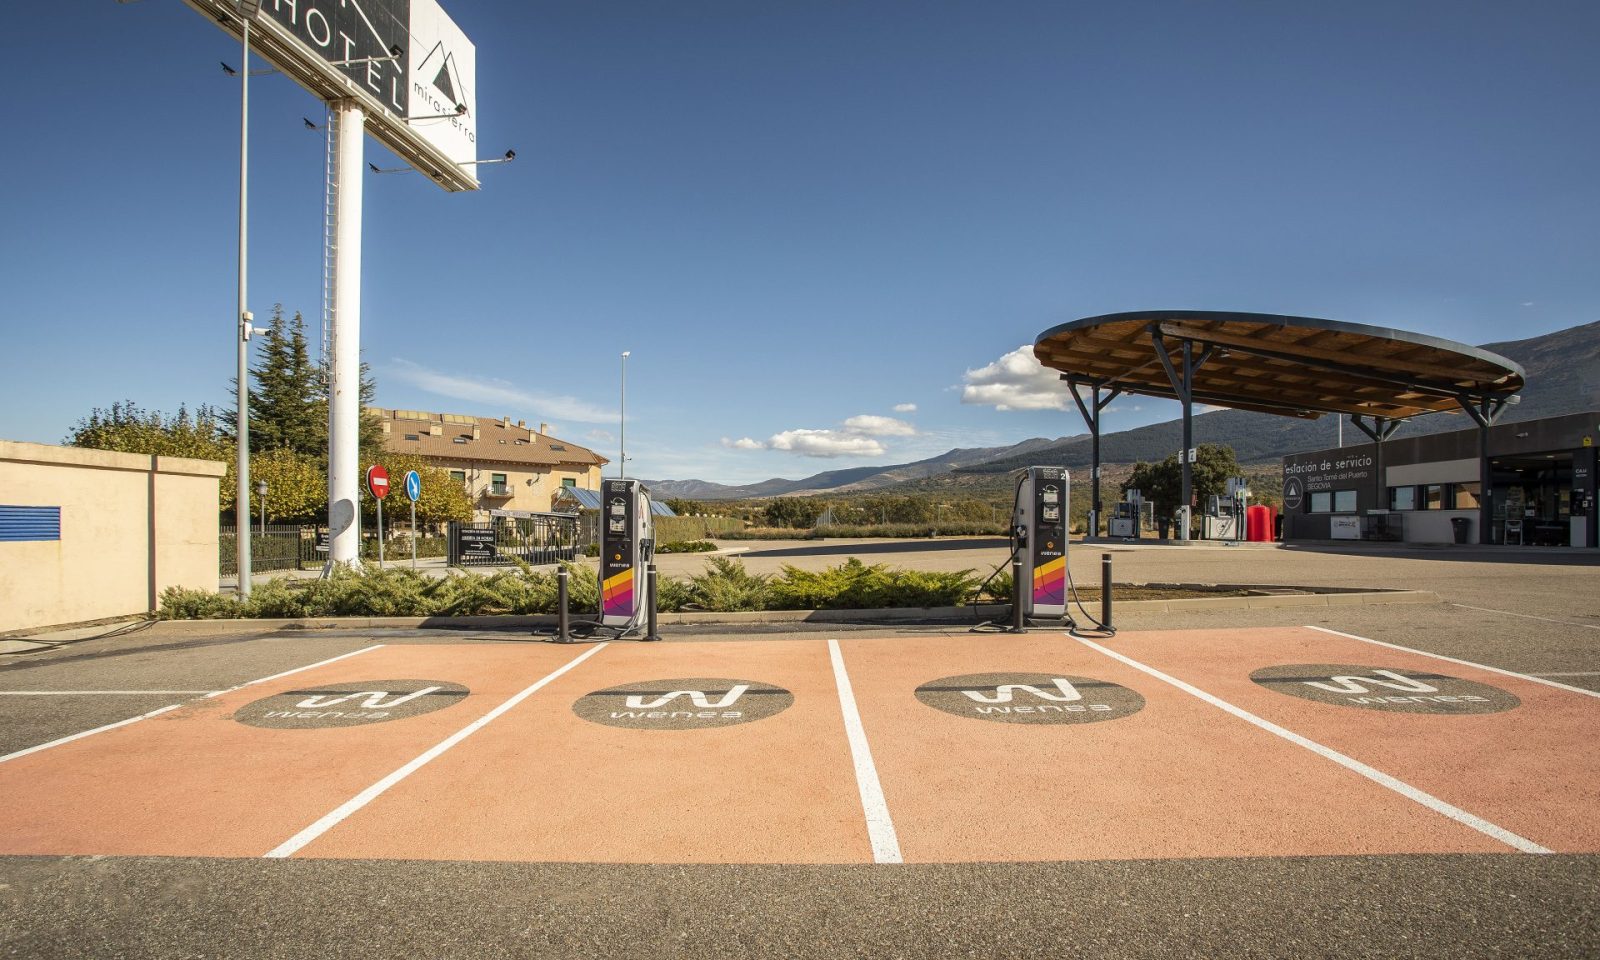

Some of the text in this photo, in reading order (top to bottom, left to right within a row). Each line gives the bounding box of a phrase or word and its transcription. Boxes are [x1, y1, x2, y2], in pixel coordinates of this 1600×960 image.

[414, 82, 475, 143] mirasierra
[1285, 454, 1372, 474] estación de servicio
